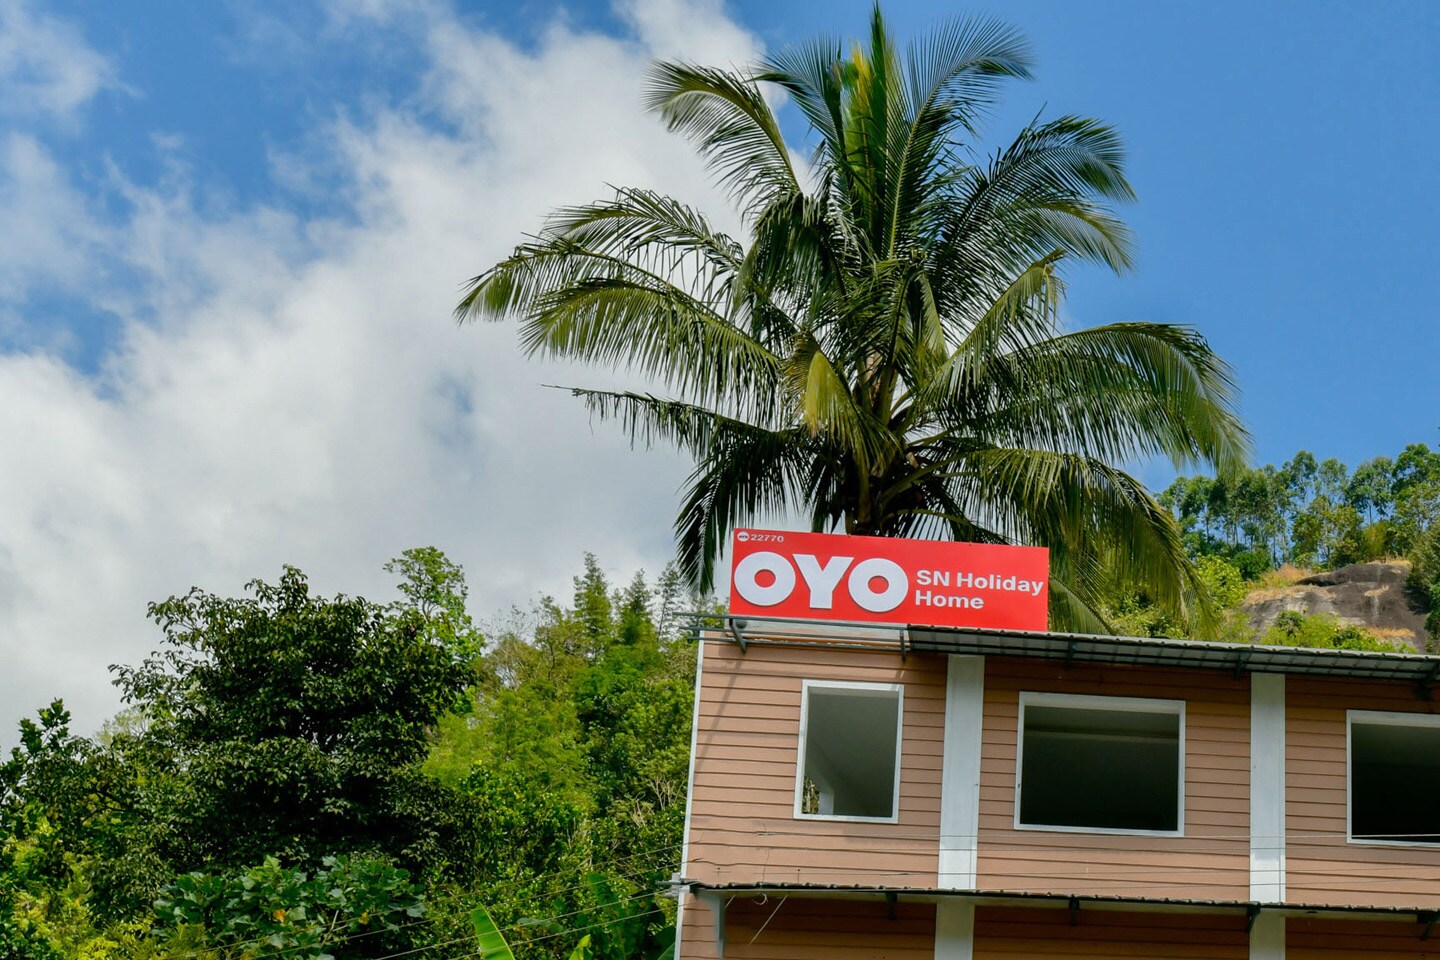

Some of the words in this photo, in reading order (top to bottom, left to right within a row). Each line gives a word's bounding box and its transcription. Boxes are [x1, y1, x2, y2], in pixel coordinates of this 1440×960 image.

[750, 533, 784, 543] 22770
[733, 551, 909, 613] OYO
[916, 569, 950, 587] SN
[956, 572, 1044, 596] Holiday
[915, 589, 984, 609] Home
